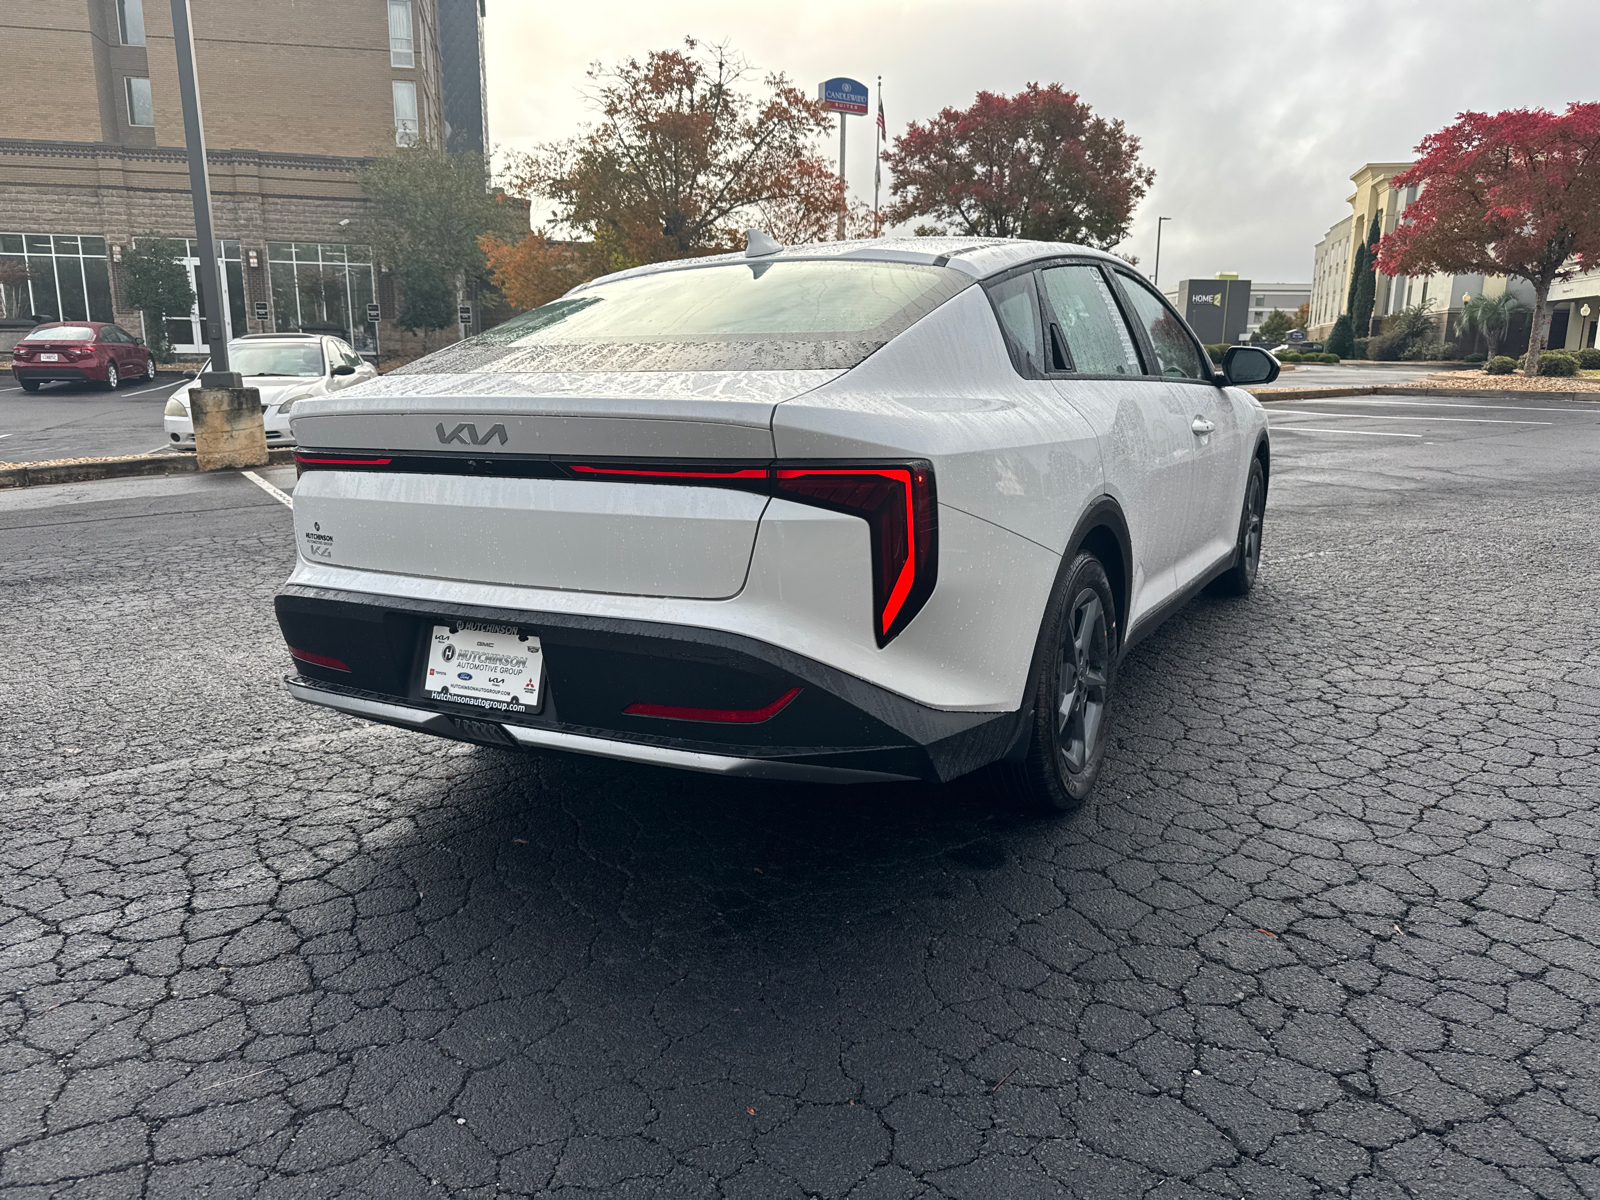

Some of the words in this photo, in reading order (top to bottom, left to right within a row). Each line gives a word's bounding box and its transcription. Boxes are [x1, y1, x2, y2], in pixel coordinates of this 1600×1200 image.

[835, 102, 858, 110] SUITES
[435, 421, 509, 445] KIA
[306, 532, 334, 542] HUTCHINSON
[311, 545, 331, 557] K4
[466, 621, 518, 636] HUTCHINSON
[457, 661, 499, 673] AUTOMOTIVE
[499, 667, 523, 676] GROUP
[450, 683, 511, 696] HUTCHINSONAUTOGROUP.COM
[431, 691, 526, 713] Hutchinsonautogroup.com
